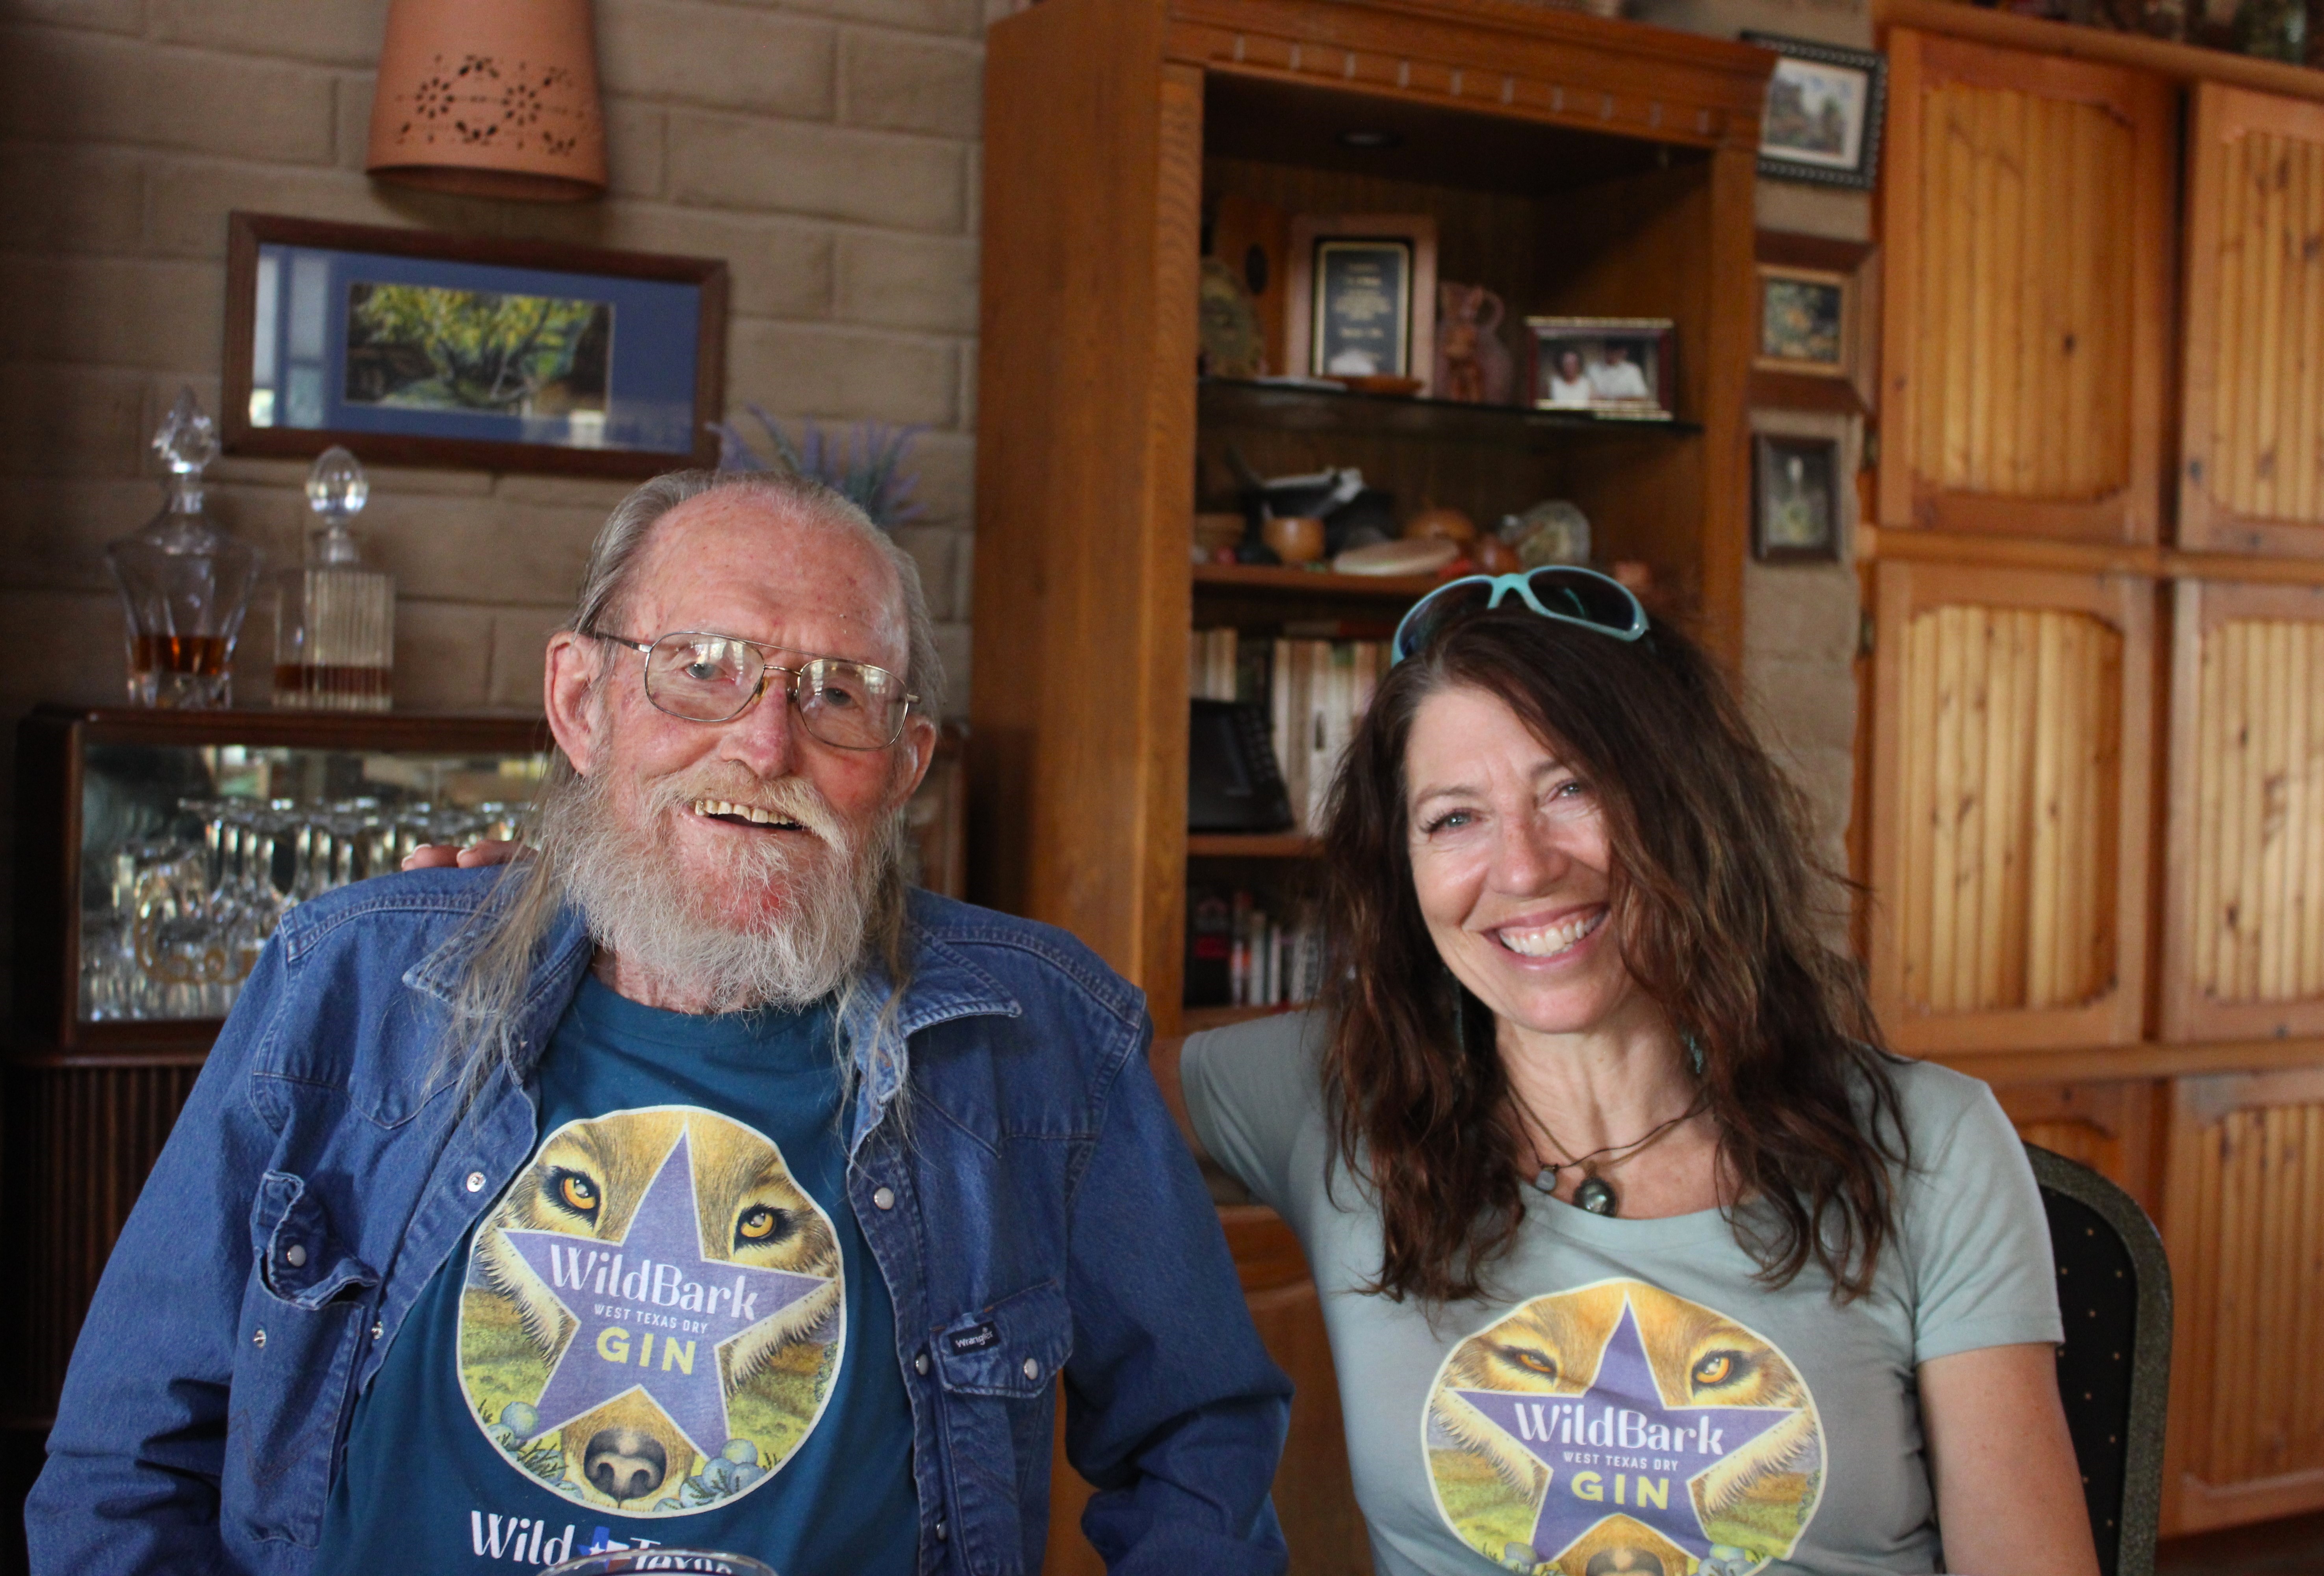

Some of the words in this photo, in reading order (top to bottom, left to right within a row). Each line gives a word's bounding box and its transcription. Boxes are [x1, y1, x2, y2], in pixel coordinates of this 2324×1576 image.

[551, 1244, 758, 1321] WildBark
[594, 1303, 631, 1320] WEST
[636, 1310, 677, 1329] TEXAS
[683, 1320, 708, 1334] DRY
[955, 1327, 993, 1347] Wrangler
[596, 1327, 696, 1375] GIN
[1514, 1403, 1724, 1455] WildBark
[1563, 1451, 1600, 1464] WEST
[1605, 1455, 1648, 1470] TEXAS
[1654, 1459, 1678, 1471] DRY
[1571, 1470, 1669, 1510] GIN
[472, 1510, 575, 1566] Wild
